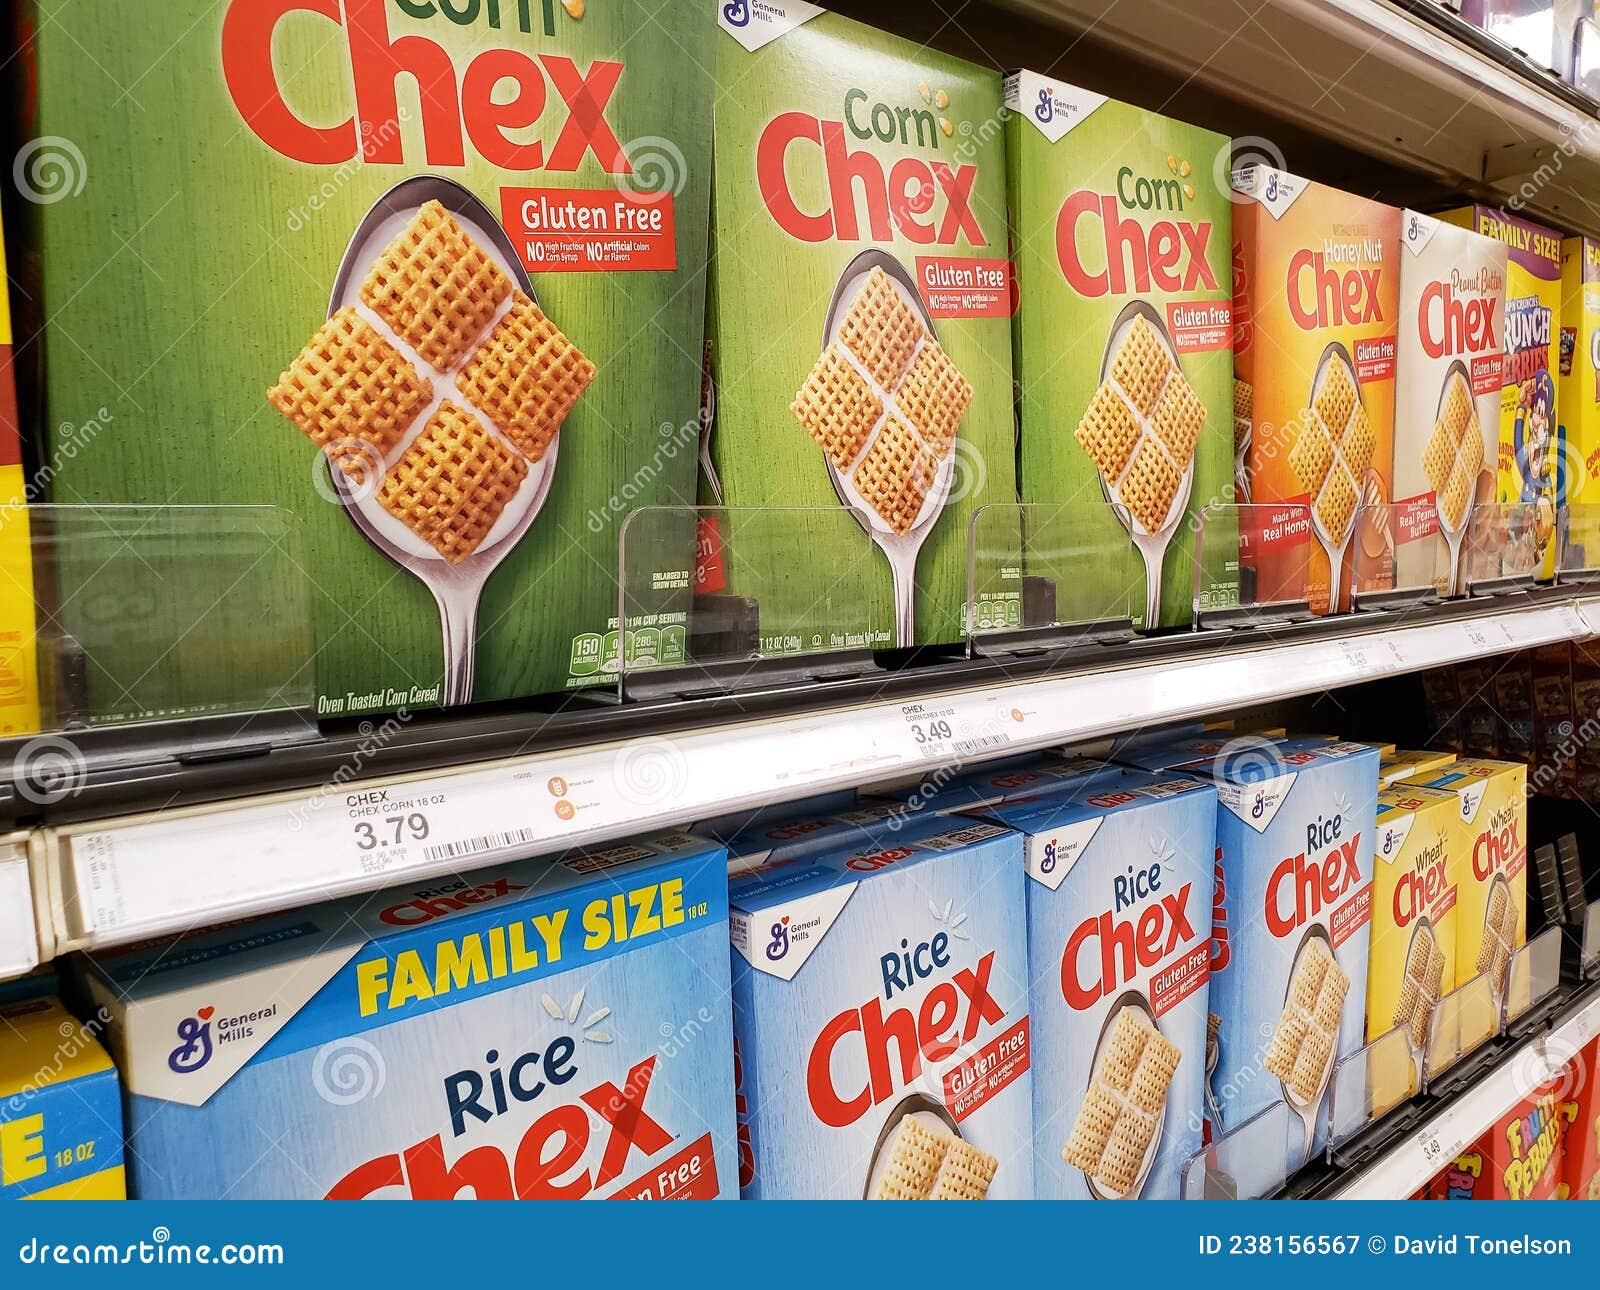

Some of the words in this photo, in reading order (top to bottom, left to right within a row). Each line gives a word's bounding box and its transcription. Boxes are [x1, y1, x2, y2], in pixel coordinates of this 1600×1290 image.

[752, 0, 786, 18] General
[752, 10, 773, 23] Mills
[221, 0, 635, 174] Chex
[1054, 99, 1078, 112] General
[1055, 108, 1069, 118] Mills
[844, 88, 938, 149] Corn
[756, 112, 988, 247] Chex
[1117, 166, 1183, 211] Corn
[521, 196, 608, 230] Gluten
[614, 202, 662, 231] Free
[545, 242, 559, 252] High
[560, 242, 585, 251] Fructose
[603, 240, 633, 252] Artificial
[633, 242, 650, 251] Colors
[1056, 190, 1219, 297] Chex
[1480, 215, 1531, 252] FAMILY
[1533, 234, 1561, 262] SIZE!
[526, 241, 544, 262] NO
[545, 253, 560, 262] Corn
[561, 252, 579, 264] Syrup
[586, 241, 603, 262] NO
[611, 252, 630, 262] Flavors
[1324, 239, 1361, 268] Honey
[1363, 239, 1382, 263] Nut
[925, 262, 973, 287] Gluten
[975, 266, 1004, 287] Free
[1451, 268, 1480, 296] Peanut
[1481, 266, 1502, 296] Butter
[929, 294, 940, 310] NO
[962, 294, 972, 310] NO
[1287, 250, 1384, 330] Chex
[1173, 306, 1208, 327] Gluten
[1209, 307, 1230, 325] Free
[1418, 281, 1497, 359] Chex
[1504, 308, 1551, 355] RUNCH
[1357, 344, 1380, 361] Gluten
[1381, 342, 1394, 357] Free
[1474, 362, 1490, 375] Gluten
[1491, 360, 1501, 372] Free
[1503, 345, 1549, 387] ERRIES
[1272, 511, 1289, 523] Made
[1290, 507, 1304, 519] With
[1400, 512, 1415, 528] Real
[1263, 526, 1283, 542] Real
[1285, 517, 1311, 537] Honey
[1411, 521, 1430, 538] Butter
[653, 571, 681, 581] ENLARGED
[681, 570, 689, 579] TO
[653, 581, 670, 590] SHOW
[670, 579, 688, 588] DETAIL
[643, 613, 658, 625] CUP
[659, 612, 687, 624] SERVING
[576, 638, 599, 656] 150
[766, 637, 773, 649] 12
[774, 637, 783, 648] OZ
[784, 635, 802, 650] (340g)
[830, 633, 844, 646] Oven
[875, 629, 891, 642] Cereal
[573, 656, 599, 665] CALORIES
[318, 695, 343, 714] Oven
[347, 689, 385, 711] Toasted
[386, 688, 408, 706] Corn
[409, 683, 440, 704] Cereal
[902, 704, 925, 716] CHEX
[905, 713, 922, 722] CORN
[922, 710, 939, 720] CHEX
[939, 710, 946, 718] 12
[911, 720, 952, 744] 3.49
[346, 790, 389, 807] CHEX
[349, 806, 380, 818] CHEX
[383, 800, 414, 813] CORN
[418, 798, 429, 807] 18
[431, 795, 446, 804] OZ
[1490, 804, 1514, 833] Wheat
[354, 813, 430, 850] 3.79
[1306, 813, 1342, 856] Rice
[844, 845, 914, 872] Chex
[1057, 841, 1078, 852] General
[1057, 851, 1070, 861] Mills
[1416, 838, 1443, 873] Wheat
[1472, 817, 1520, 882] Chex
[415, 881, 467, 900] Rice
[1113, 862, 1161, 913] Rice
[1264, 832, 1361, 938] Chex
[1393, 854, 1448, 928] Chex
[377, 878, 529, 926] Chex
[1333, 902, 1356, 929] Gluten
[1357, 891, 1370, 910] Free
[790, 916, 821, 933] General
[356, 909, 568, 1017] FAMILY
[582, 877, 685, 953] SIZE
[688, 905, 697, 920] 18
[697, 902, 708, 918] OZ
[791, 931, 809, 943] Mills
[1060, 882, 1196, 1011] Chex
[880, 931, 952, 1000] Rice
[1155, 963, 1187, 995] Gluten
[1188, 949, 1208, 972] Free
[217, 1004, 277, 1030] General
[218, 1026, 254, 1045] Mills
[806, 950, 1006, 1128] Chex
[951, 1052, 997, 1094] Gluten
[998, 1030, 1025, 1060] Free
[444, 1035, 579, 1138] Rice
[988, 1074, 998, 1090] NO
[954, 1099, 965, 1116] NO
[322, 1054, 676, 1200] hex
[55, 1147, 73, 1169] 18
[76, 1141, 96, 1162] OZ
[1424, 1140, 1441, 1160] 3.49
[658, 1155, 701, 1197] Free
